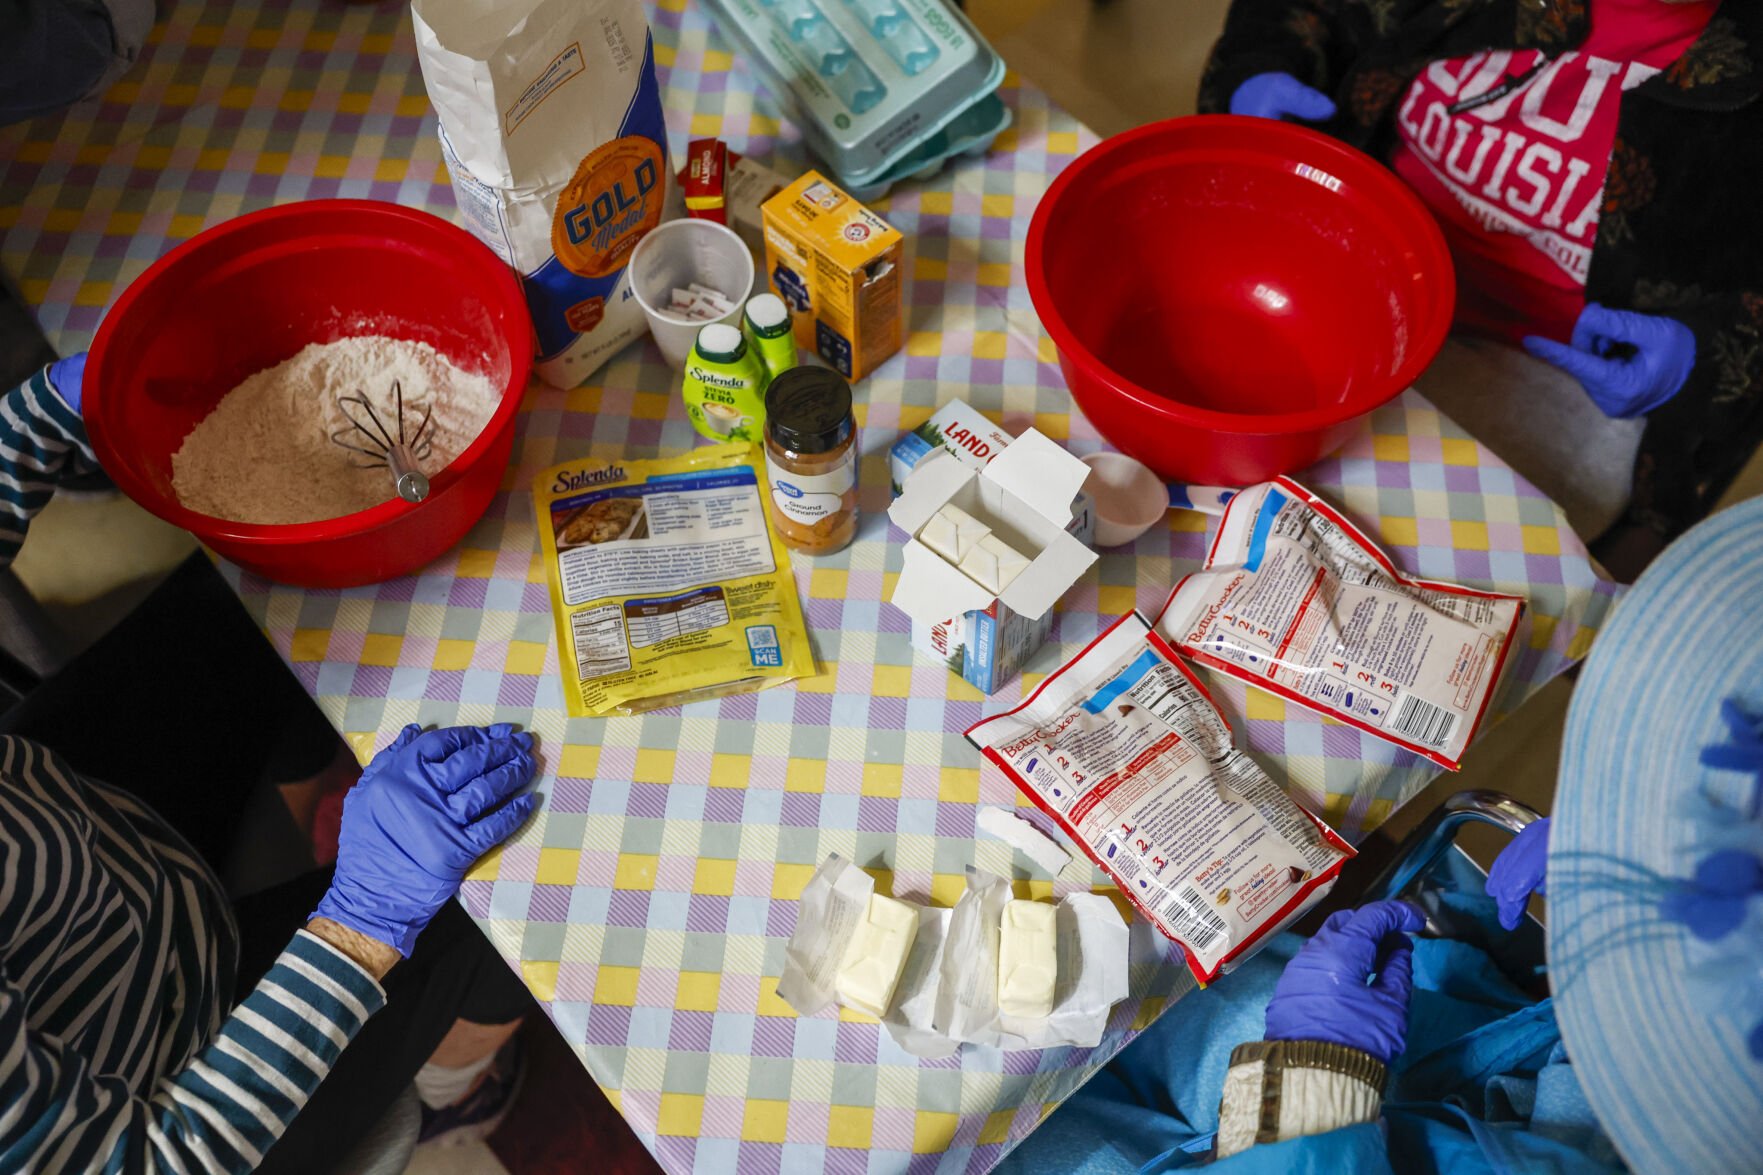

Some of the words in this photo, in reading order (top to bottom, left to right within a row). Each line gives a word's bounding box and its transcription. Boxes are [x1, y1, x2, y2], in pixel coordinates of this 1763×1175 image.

[563, 157, 656, 245] GOLD
[592, 199, 646, 254] Medal
[689, 367, 744, 388] Splenda
[703, 391, 735, 405] ZERO
[943, 421, 990, 458] LAND
[552, 465, 625, 493] Splenda
[784, 504, 828, 516] Cinnamon
[789, 501, 822, 511] Ground
[572, 609, 601, 619] Nutrition
[602, 605, 620, 613] Facts
[1189, 612, 1216, 642] Betty
[1209, 575, 1244, 614] Crocker
[1223, 613, 1232, 622] 1
[1238, 620, 1249, 630] 2
[1257, 628, 1268, 639] 3
[755, 654, 779, 665] ME
[1356, 670, 1369, 681] 2
[1128, 675, 1155, 697] Nutrition
[1380, 680, 1393, 692] 3
[1158, 703, 1177, 718] Calories
[1002, 730, 1038, 759] Betty
[1044, 742, 1053, 752] 1
[1056, 754, 1069, 767] 2
[1070, 769, 1083, 783] 3
[1120, 821, 1131, 833] 1
[1135, 837, 1148, 851] 2
[1152, 855, 1164, 867] 3
[1195, 866, 1213, 882] Betty's
[1233, 882, 1248, 894] Follow
[1260, 863, 1272, 873] more
[1239, 887, 1252, 899] great
